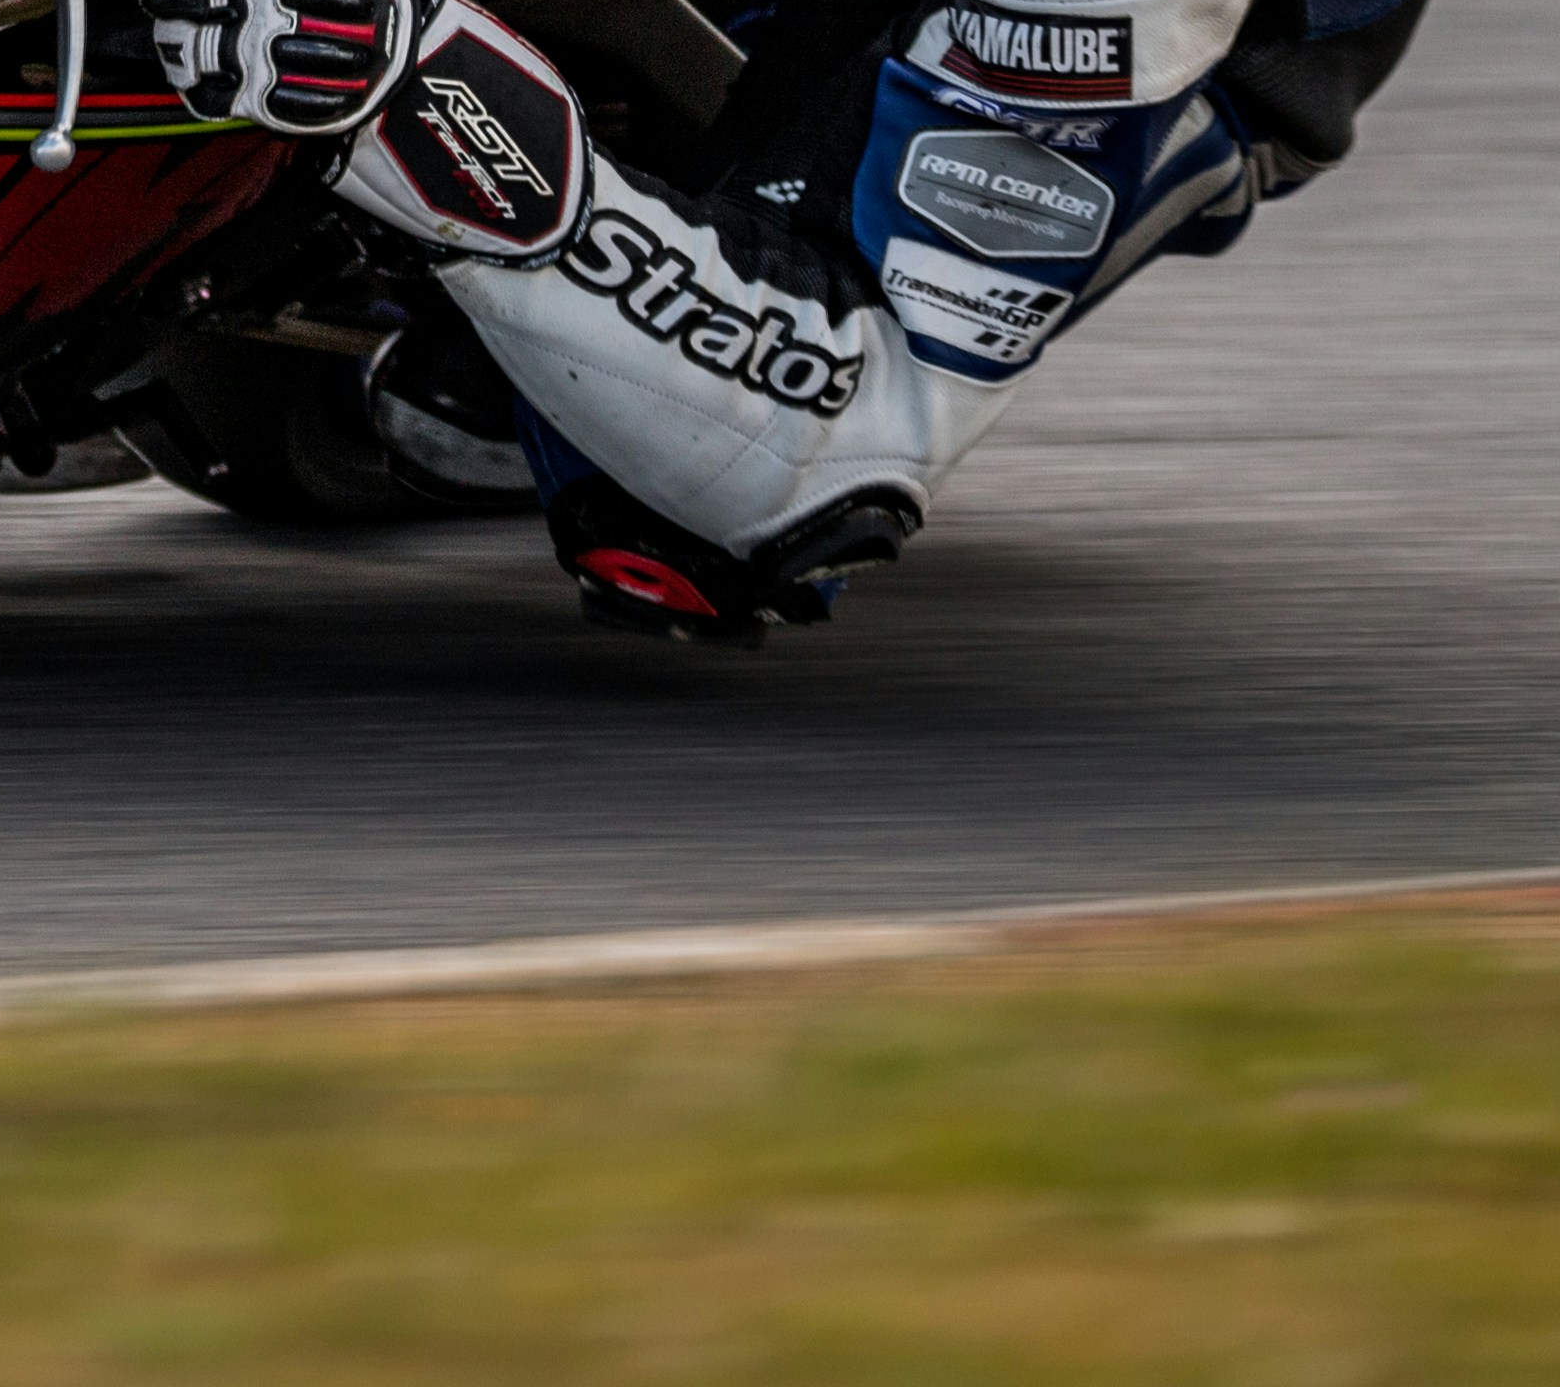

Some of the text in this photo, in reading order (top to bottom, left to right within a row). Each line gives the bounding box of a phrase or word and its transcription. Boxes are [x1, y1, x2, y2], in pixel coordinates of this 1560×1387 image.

[949, 16, 1121, 76] YAMALUBE
[417, 101, 517, 220] TracTech
[421, 76, 555, 197] RST
[562, 209, 866, 417] Stratos
